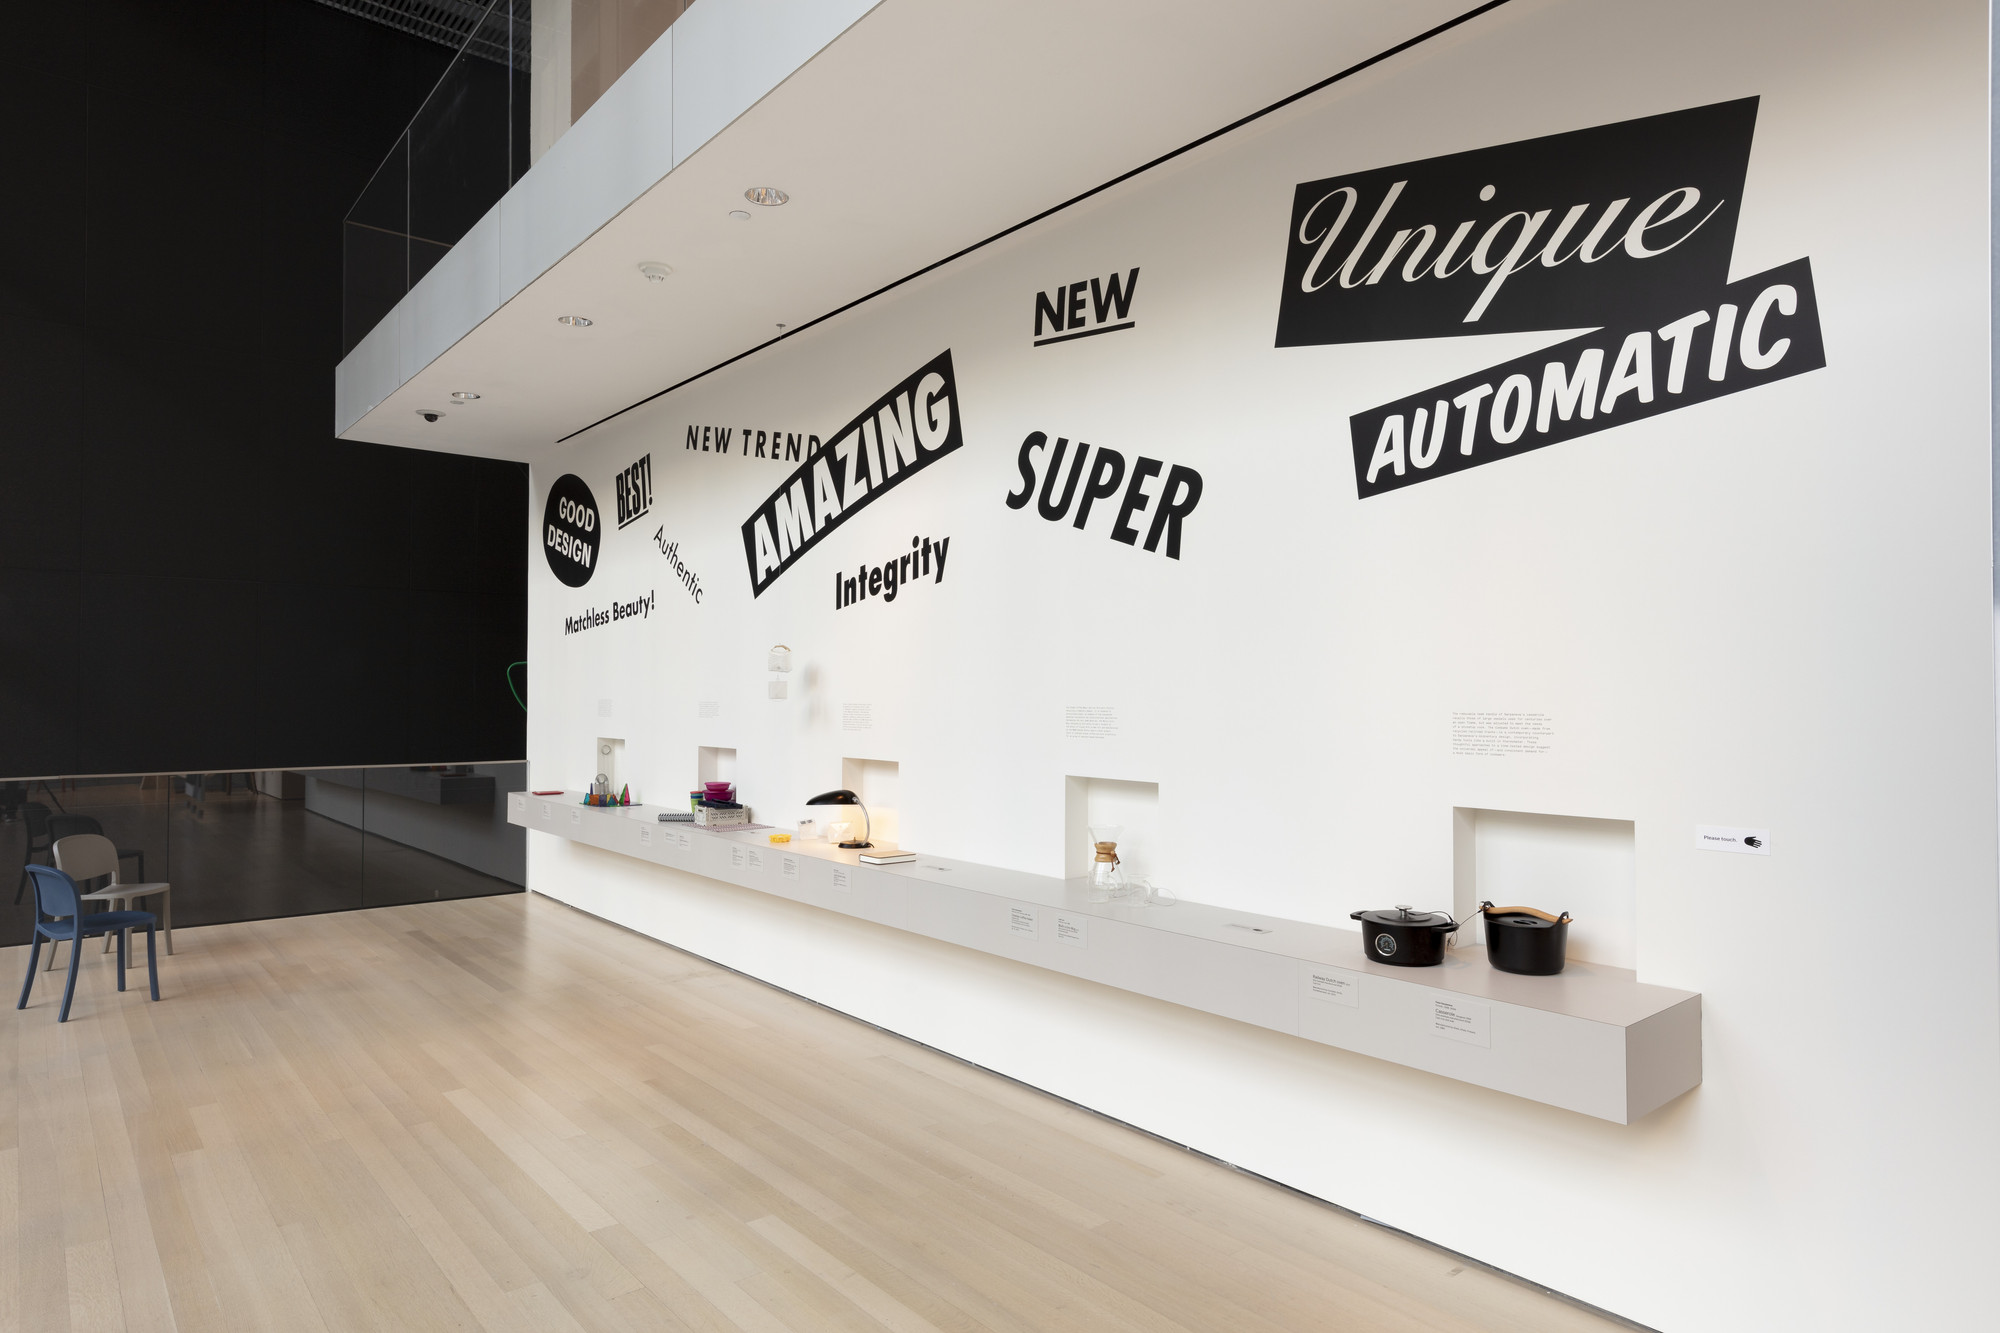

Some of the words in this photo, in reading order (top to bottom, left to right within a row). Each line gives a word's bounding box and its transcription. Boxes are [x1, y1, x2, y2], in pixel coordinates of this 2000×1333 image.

[1299, 179, 1725, 324] Unique
[1033, 266, 1141, 338] NEW
[1366, 284, 1798, 484] AUTOMATIC
[685, 424, 732, 454] NEW
[742, 428, 822, 463] TREND
[753, 371, 951, 586] AMAZING
[559, 496, 596, 532] GOOD
[615, 452, 653, 526] BEST!
[1005, 430, 1204, 561] SUPER
[547, 524, 592, 568] DESIGN
[653, 523, 703, 605] Authentic
[836, 535, 950, 611] Integrity
[564, 606, 610, 636] Matchless
[612, 589, 655, 619] Beauty!
[1703, 834, 1721, 842] Please
